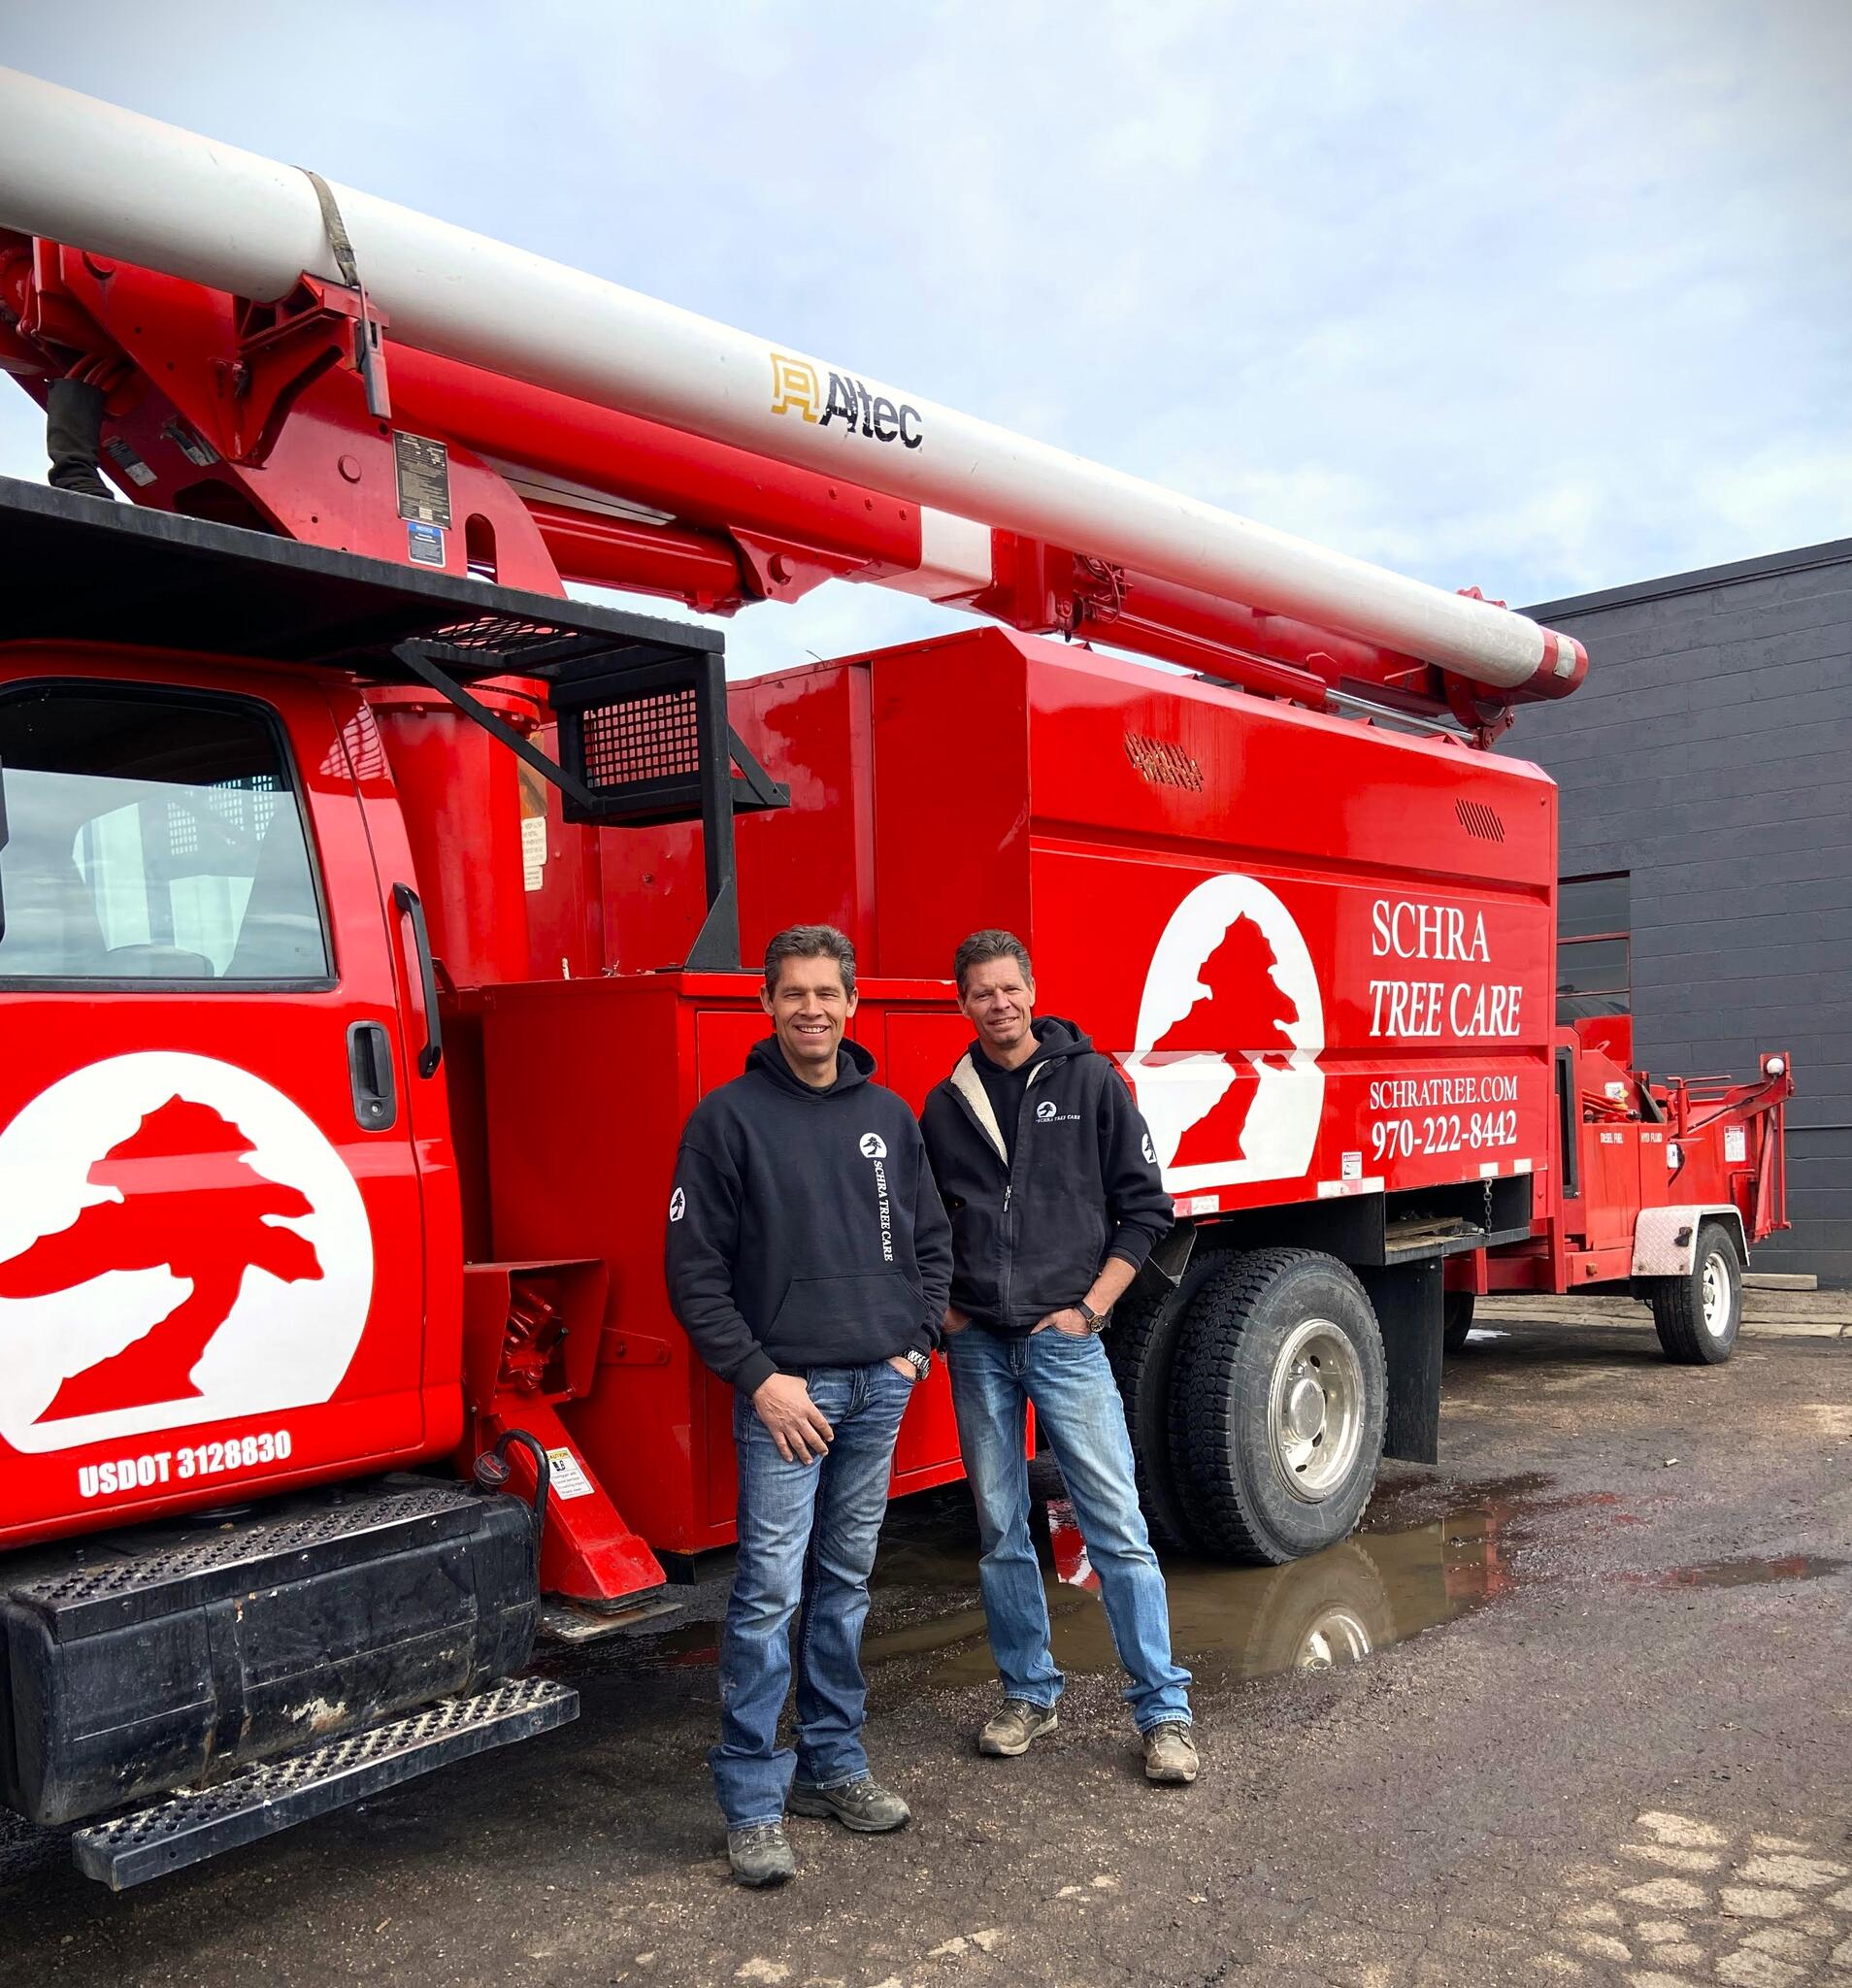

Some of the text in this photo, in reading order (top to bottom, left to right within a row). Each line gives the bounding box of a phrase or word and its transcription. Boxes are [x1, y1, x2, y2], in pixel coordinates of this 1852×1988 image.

[819, 372, 922, 448] Altec
[1372, 899, 1491, 963] SCHRA
[1369, 980, 1522, 1037] TREE CARE
[1370, 1076, 1518, 1110] SCHRATREE.COM
[1372, 1110, 1517, 1162] 970-222-8442
[874, 1160, 893, 1262] SCHRA TREE CARE
[79, 1430, 292, 1498] USDOT 3128830
